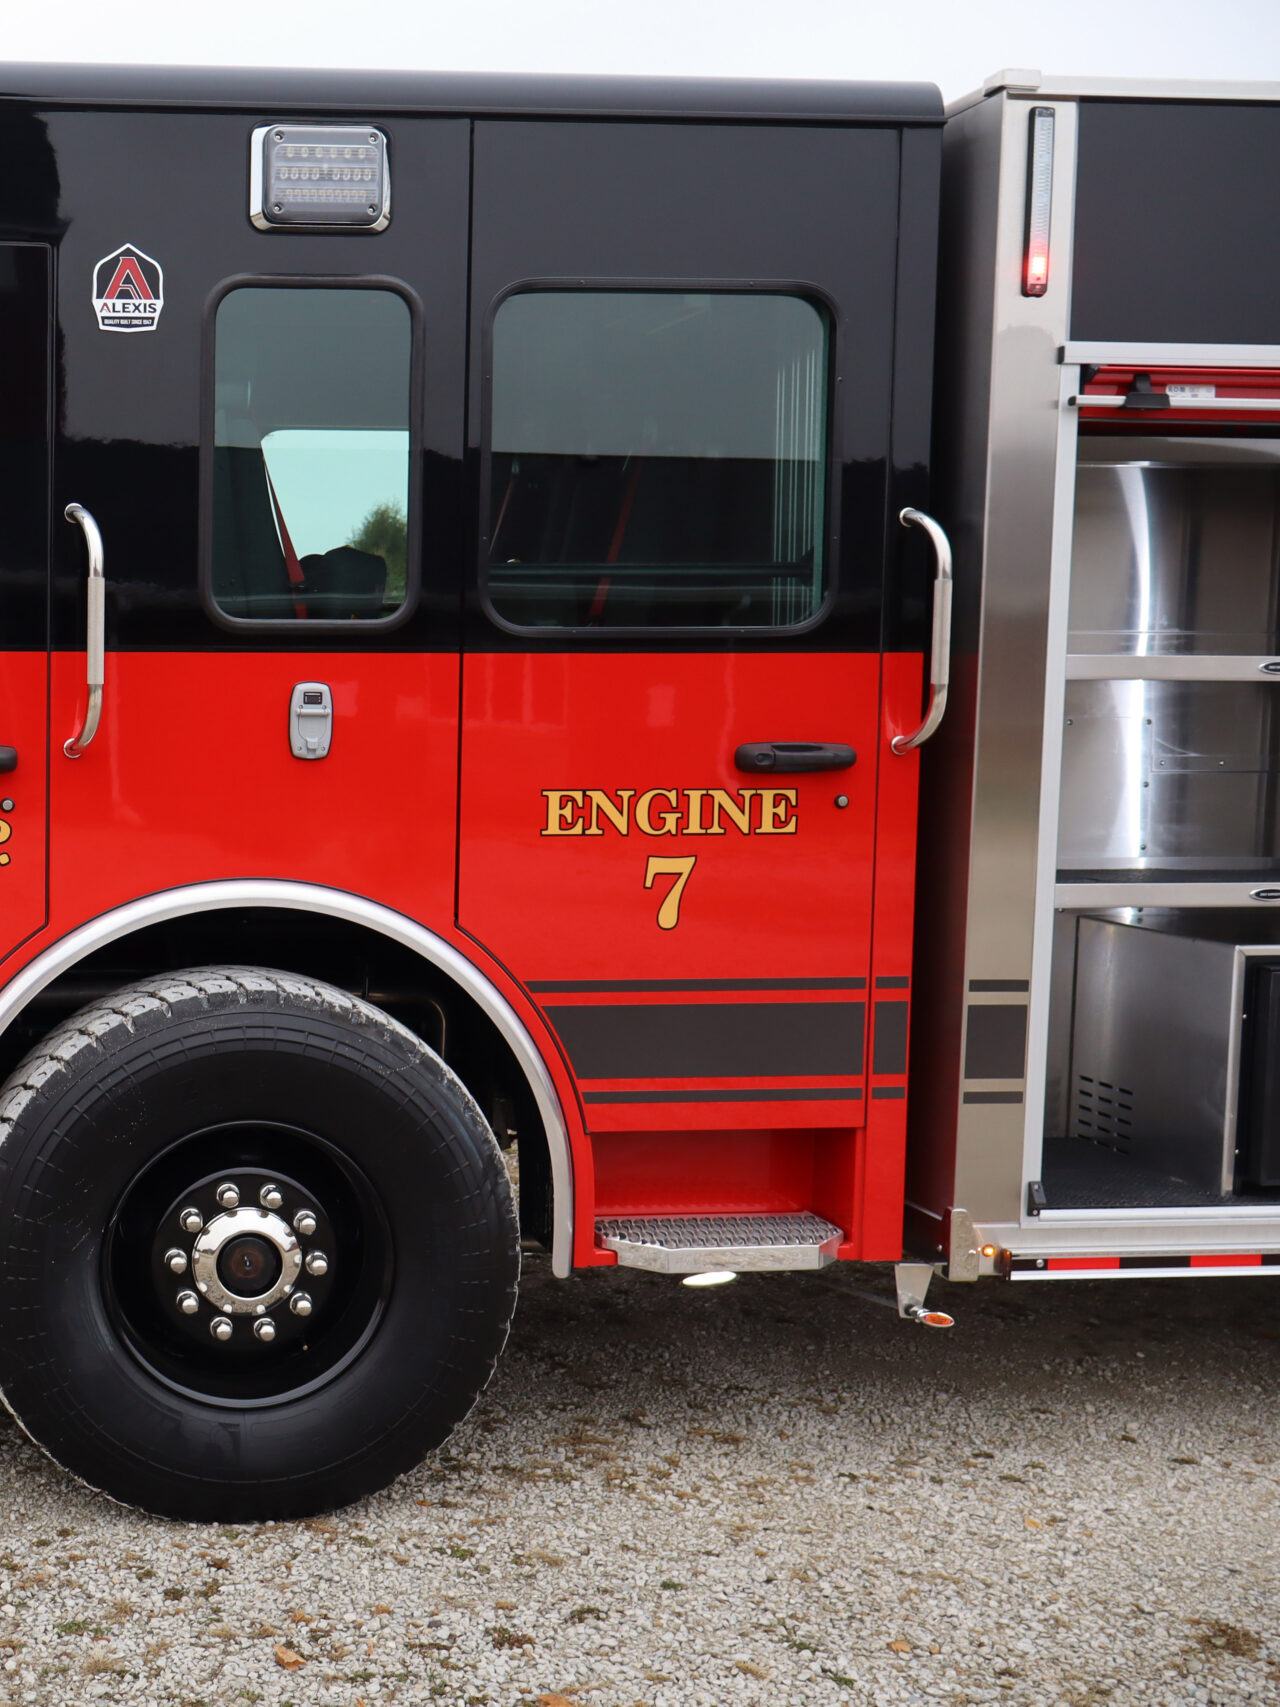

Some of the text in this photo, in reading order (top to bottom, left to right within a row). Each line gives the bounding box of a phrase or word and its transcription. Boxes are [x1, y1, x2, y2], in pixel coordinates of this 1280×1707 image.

[99, 302, 157, 313] ALEXIS
[540, 788, 799, 836] ENGINE
[643, 855, 698, 930] 7
